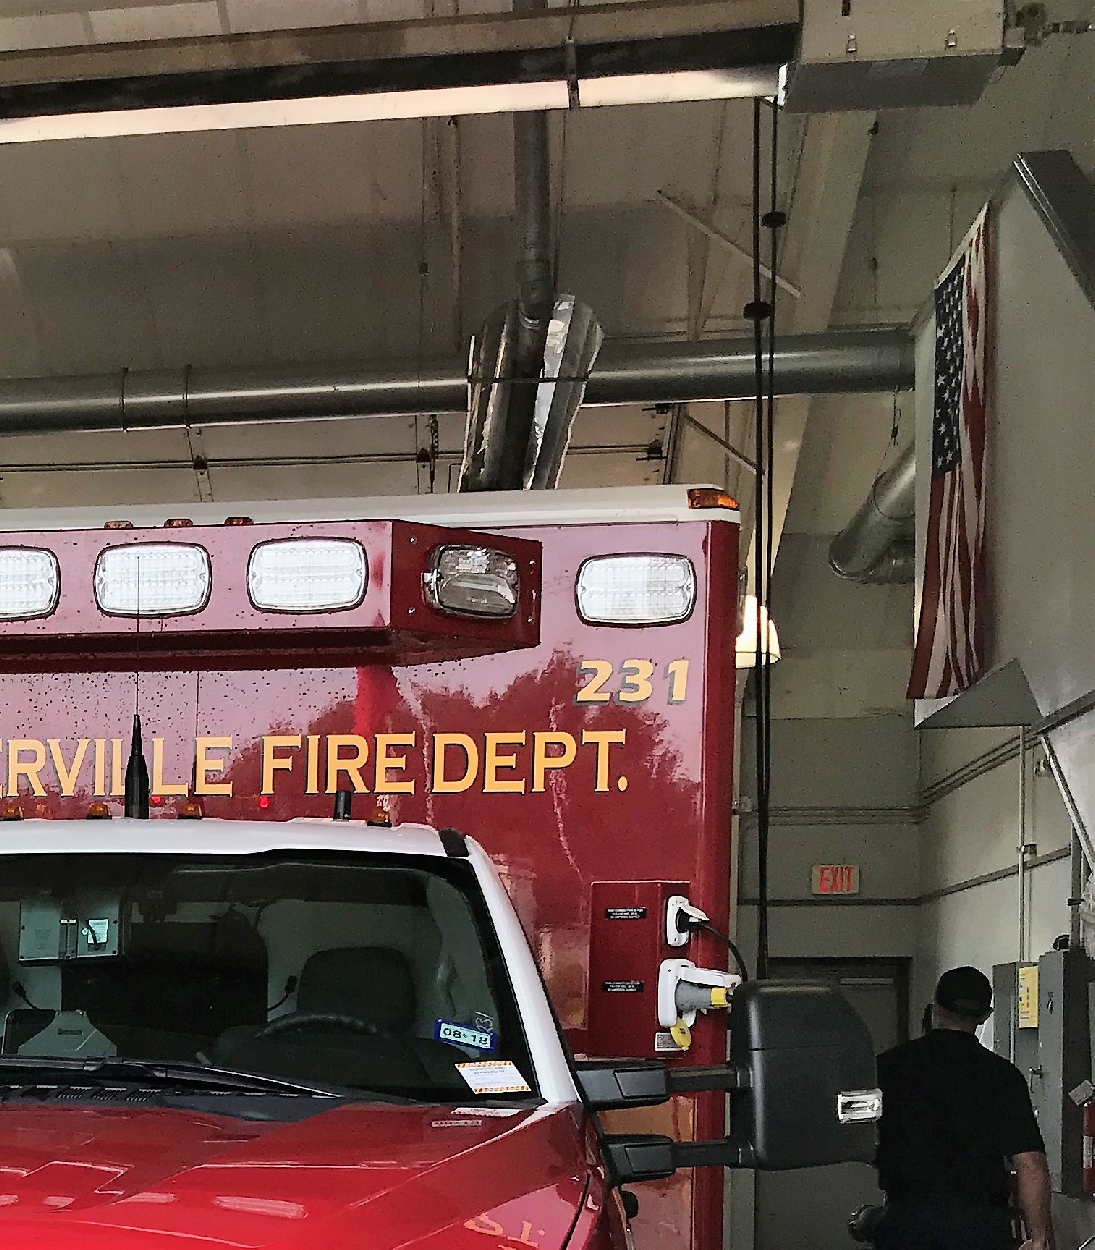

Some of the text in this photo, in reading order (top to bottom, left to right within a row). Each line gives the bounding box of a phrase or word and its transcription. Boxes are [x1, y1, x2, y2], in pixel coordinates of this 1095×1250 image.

[574, 659, 690, 704] 231
[260, 732, 416, 796] FIRE
[431, 728, 629, 795] DEPT.
[819, 866, 855, 893] EXIT
